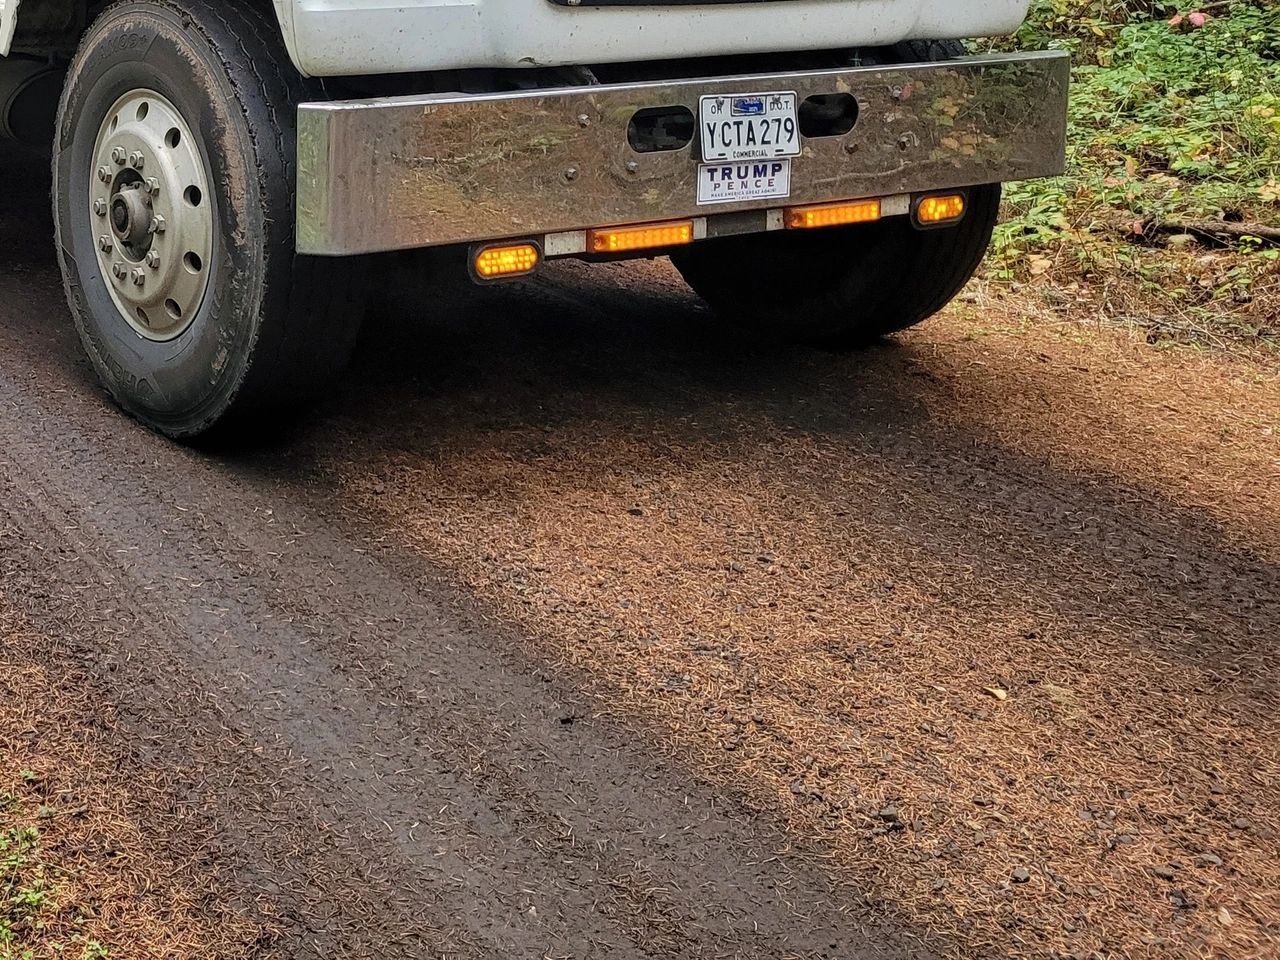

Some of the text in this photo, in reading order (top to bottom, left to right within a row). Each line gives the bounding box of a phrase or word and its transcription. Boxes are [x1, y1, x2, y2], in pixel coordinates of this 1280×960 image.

[706, 117, 795, 149] YCTA279
[732, 150, 769, 159] COMMERCIAL
[707, 163, 783, 182] TRUMP
[713, 178, 775, 192] PENCE
